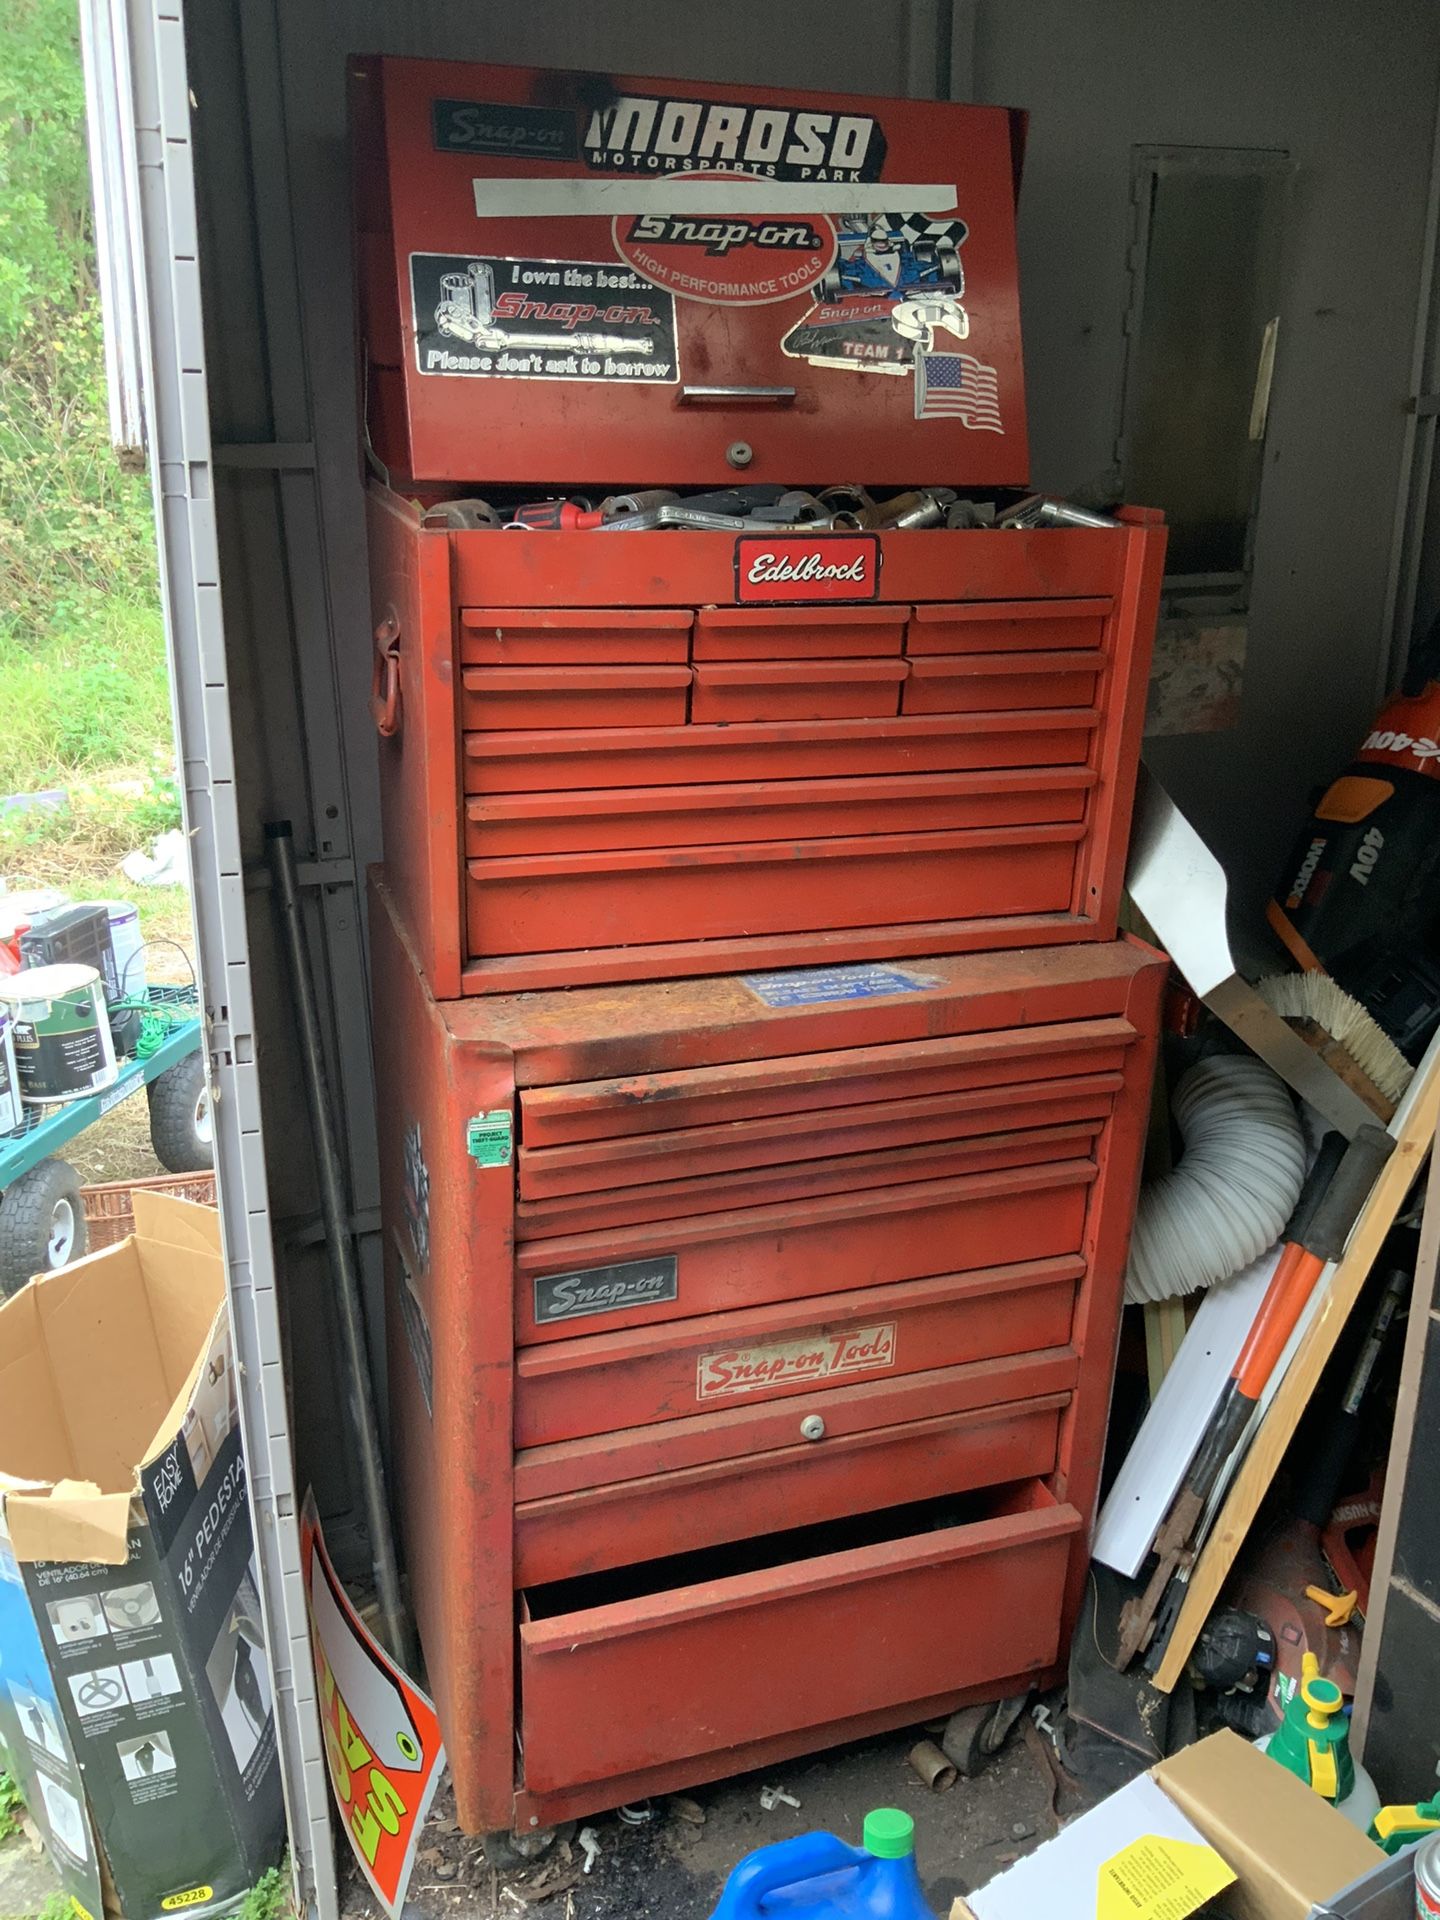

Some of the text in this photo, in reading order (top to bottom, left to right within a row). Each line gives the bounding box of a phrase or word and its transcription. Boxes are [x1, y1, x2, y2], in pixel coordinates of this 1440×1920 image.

[449, 108, 564, 148] Snap-on
[584, 97, 874, 169] MOROSO
[592, 150, 861, 183] MOTORSPORTS PARK
[633, 214, 810, 250] Snap-on
[511, 265, 653, 290] I own the best...
[632, 248, 823, 296] HIGH PERFORMANCE TOOLS
[427, 350, 671, 377] Please don't ask to borrow
[842, 341, 904, 359] TEAM 1
[747, 553, 866, 584] Edelbrock
[1360, 730, 1414, 752] 40V
[1350, 826, 1385, 886] 40V
[549, 1273, 665, 1314] Snap-on
[704, 1327, 892, 1391] Snap-on Tools
[153, 1441, 180, 1500] EASY
[159, 1470, 184, 1515] HOME
[195, 1455, 245, 1559] PEDESTA
[36, 1564, 88, 1579] VENTILADOR
[38, 1579, 51, 1587] DE
[168, 1889, 206, 1905] 45228
